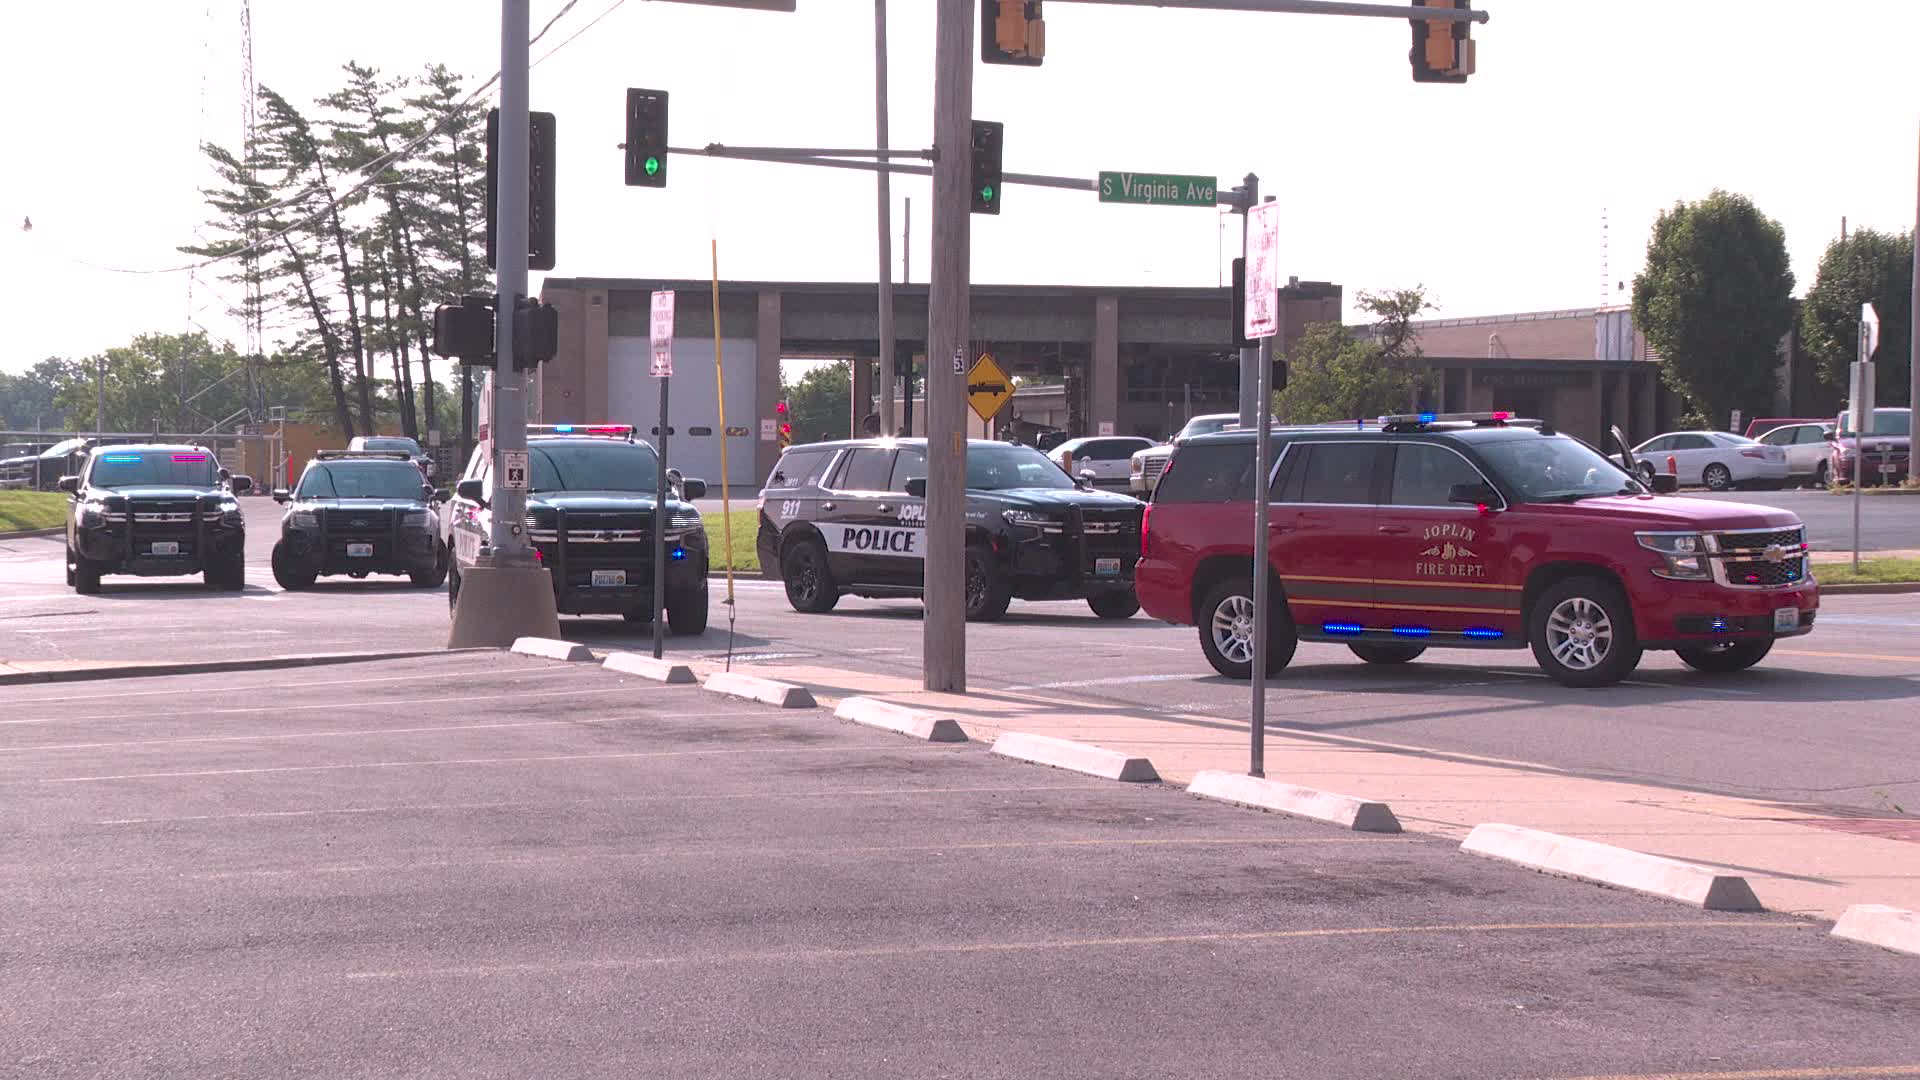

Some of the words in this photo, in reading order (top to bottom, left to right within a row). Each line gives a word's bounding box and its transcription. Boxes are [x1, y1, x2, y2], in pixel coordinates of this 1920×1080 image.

[1103, 178, 1112, 196] S
[1120, 173, 1179, 203] Virginia
[1186, 182, 1213, 200] Ave
[781, 500, 801, 516] 911
[897, 504, 926, 521] JOPLI
[842, 528, 916, 553] POLICE
[1424, 524, 1476, 541] JOPLIN
[1416, 562, 1445, 576] FIRE
[1450, 563, 1485, 577] DEPT.
